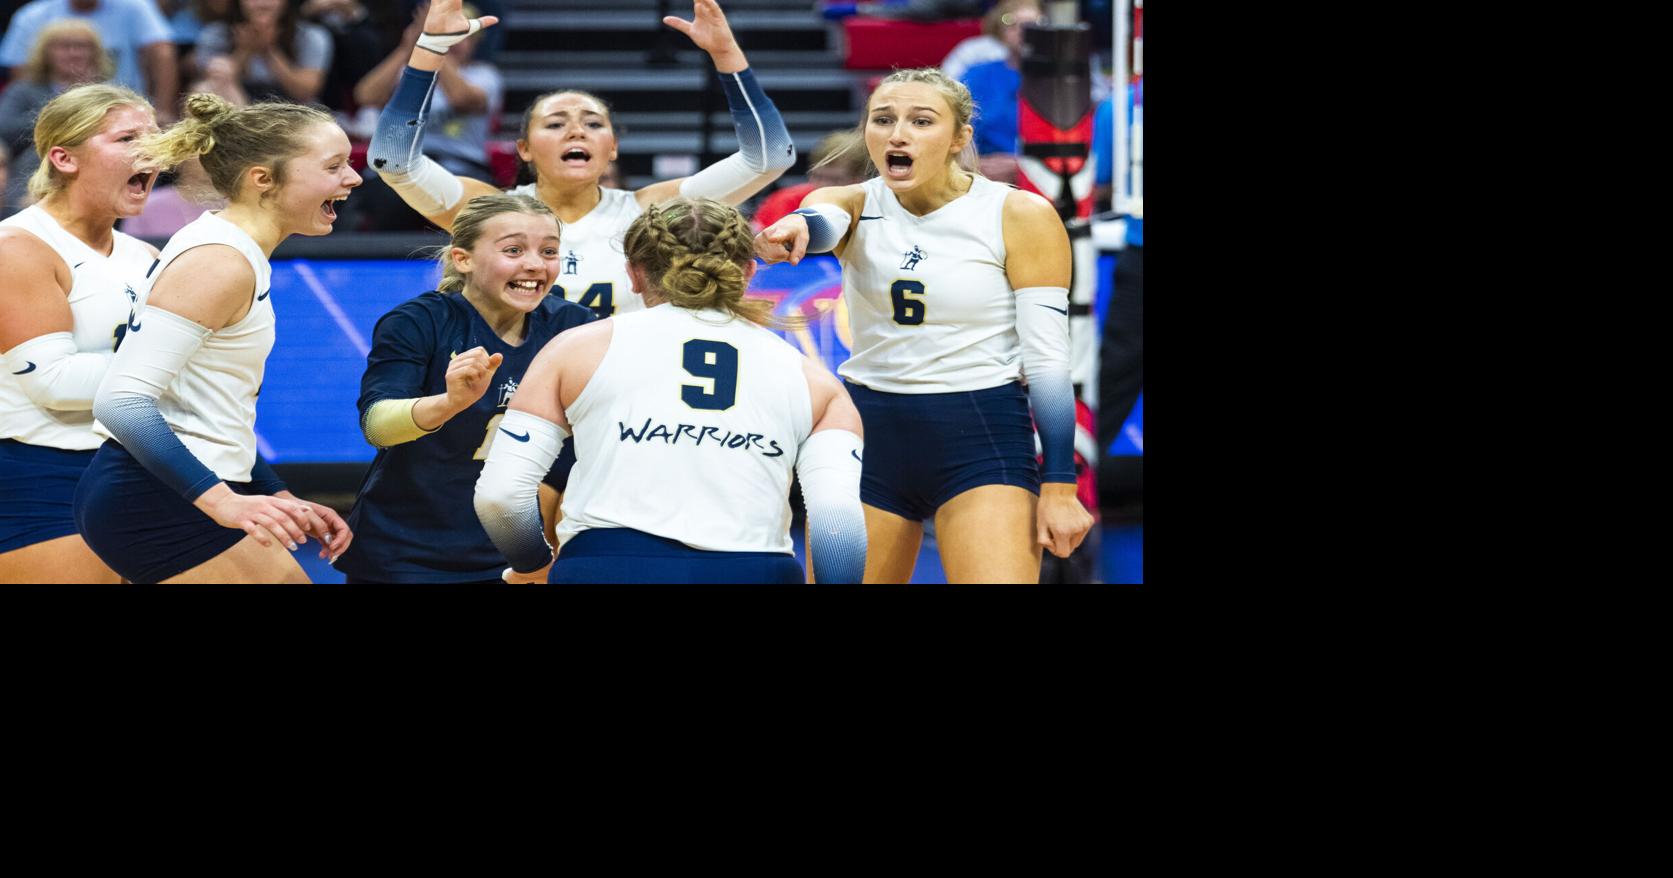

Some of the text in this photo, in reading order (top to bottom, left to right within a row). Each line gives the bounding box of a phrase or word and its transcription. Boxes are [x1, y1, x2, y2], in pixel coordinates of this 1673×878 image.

[549, 282, 617, 319] 4
[890, 278, 927, 327] 6
[680, 337, 740, 412] 9
[618, 417, 784, 457] WARRIORS
